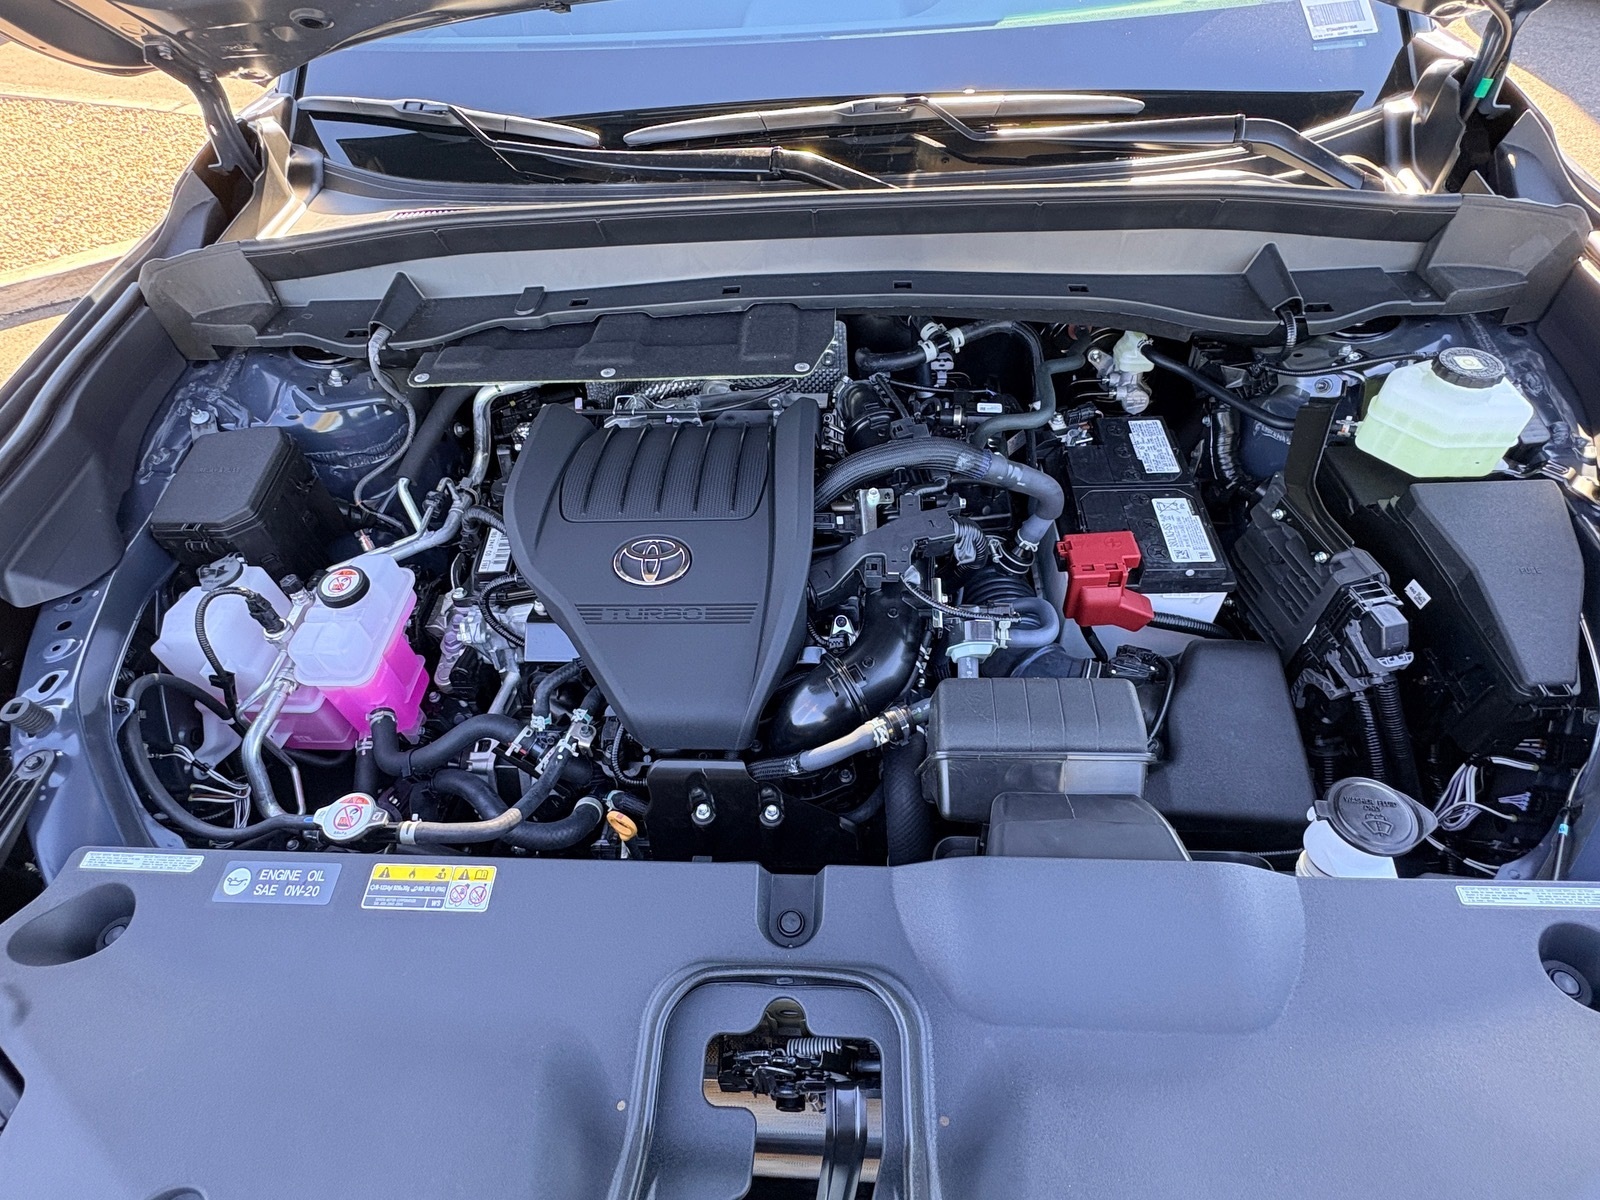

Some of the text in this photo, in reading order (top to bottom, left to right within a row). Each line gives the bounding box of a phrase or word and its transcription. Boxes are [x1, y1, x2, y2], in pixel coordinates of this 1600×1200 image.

[606, 607, 703, 620] TURBO
[1343, 796, 1397, 808] WASHER FLUID
[259, 869, 325, 882] ENGINE OIL
[253, 884, 320, 897] SAE 0W-20
